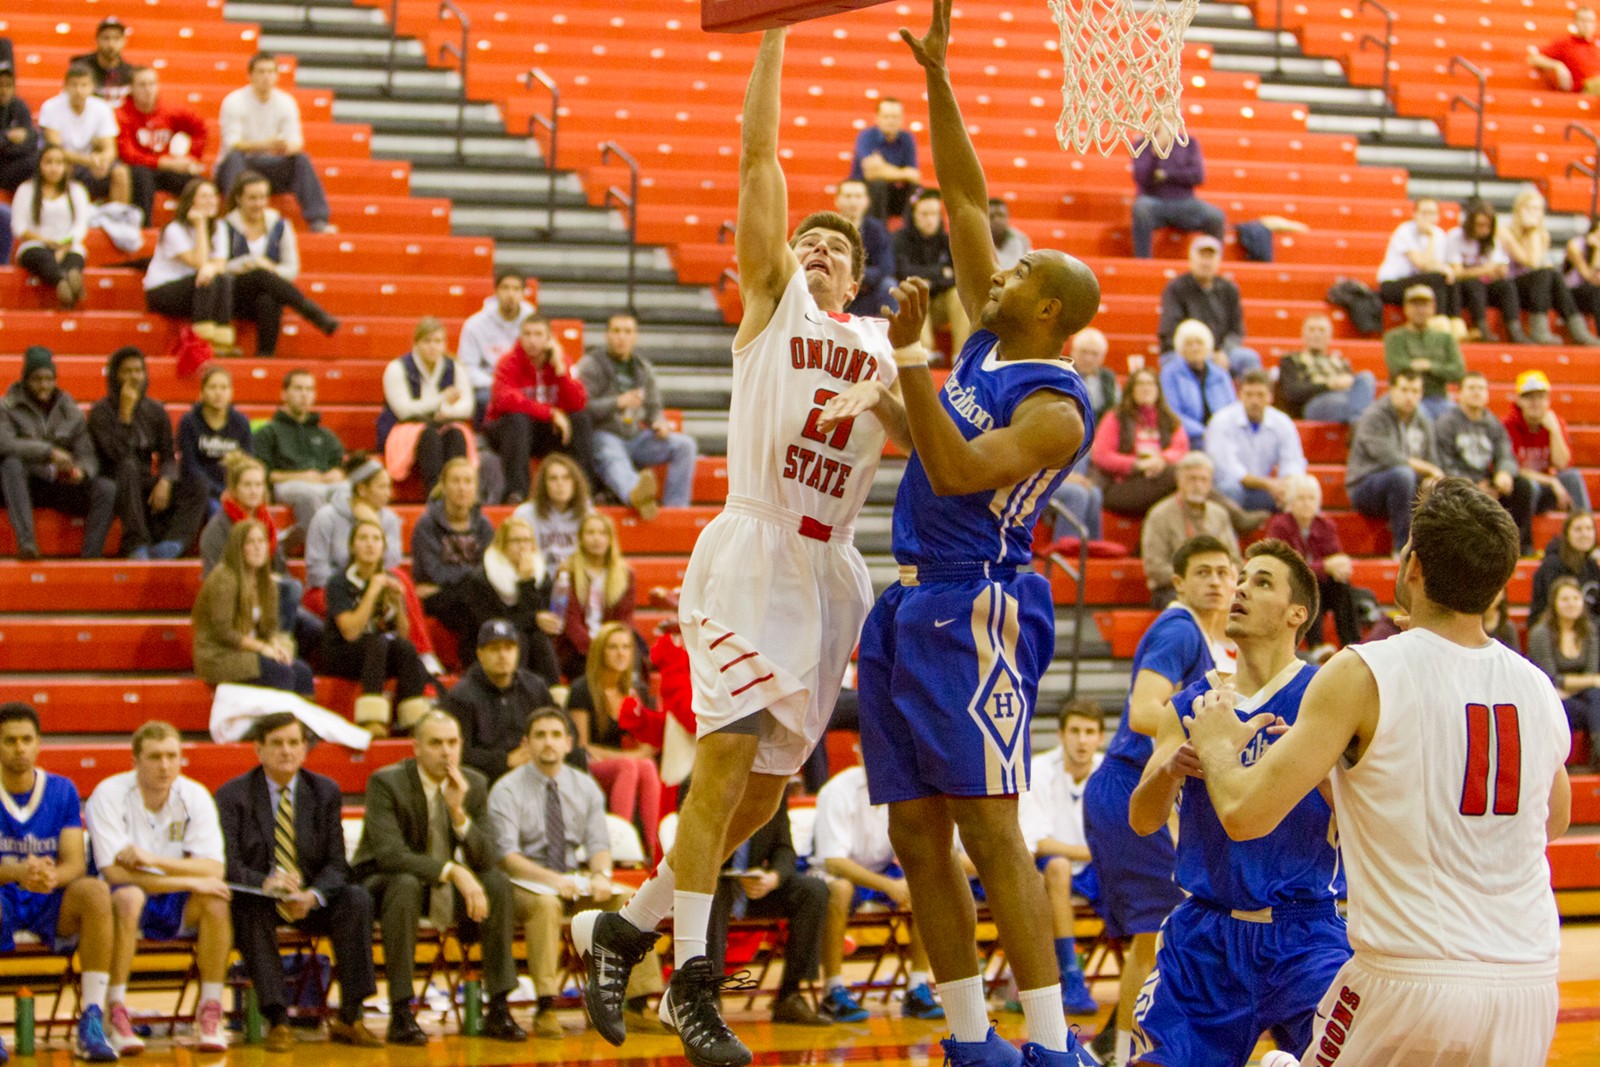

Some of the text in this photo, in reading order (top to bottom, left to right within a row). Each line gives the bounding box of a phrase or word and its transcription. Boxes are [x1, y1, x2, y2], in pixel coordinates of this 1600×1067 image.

[783, 444, 852, 499] STATE
[993, 692, 1014, 718] H
[1459, 702, 1521, 816] 11
[0, 831, 58, 854] amilton
